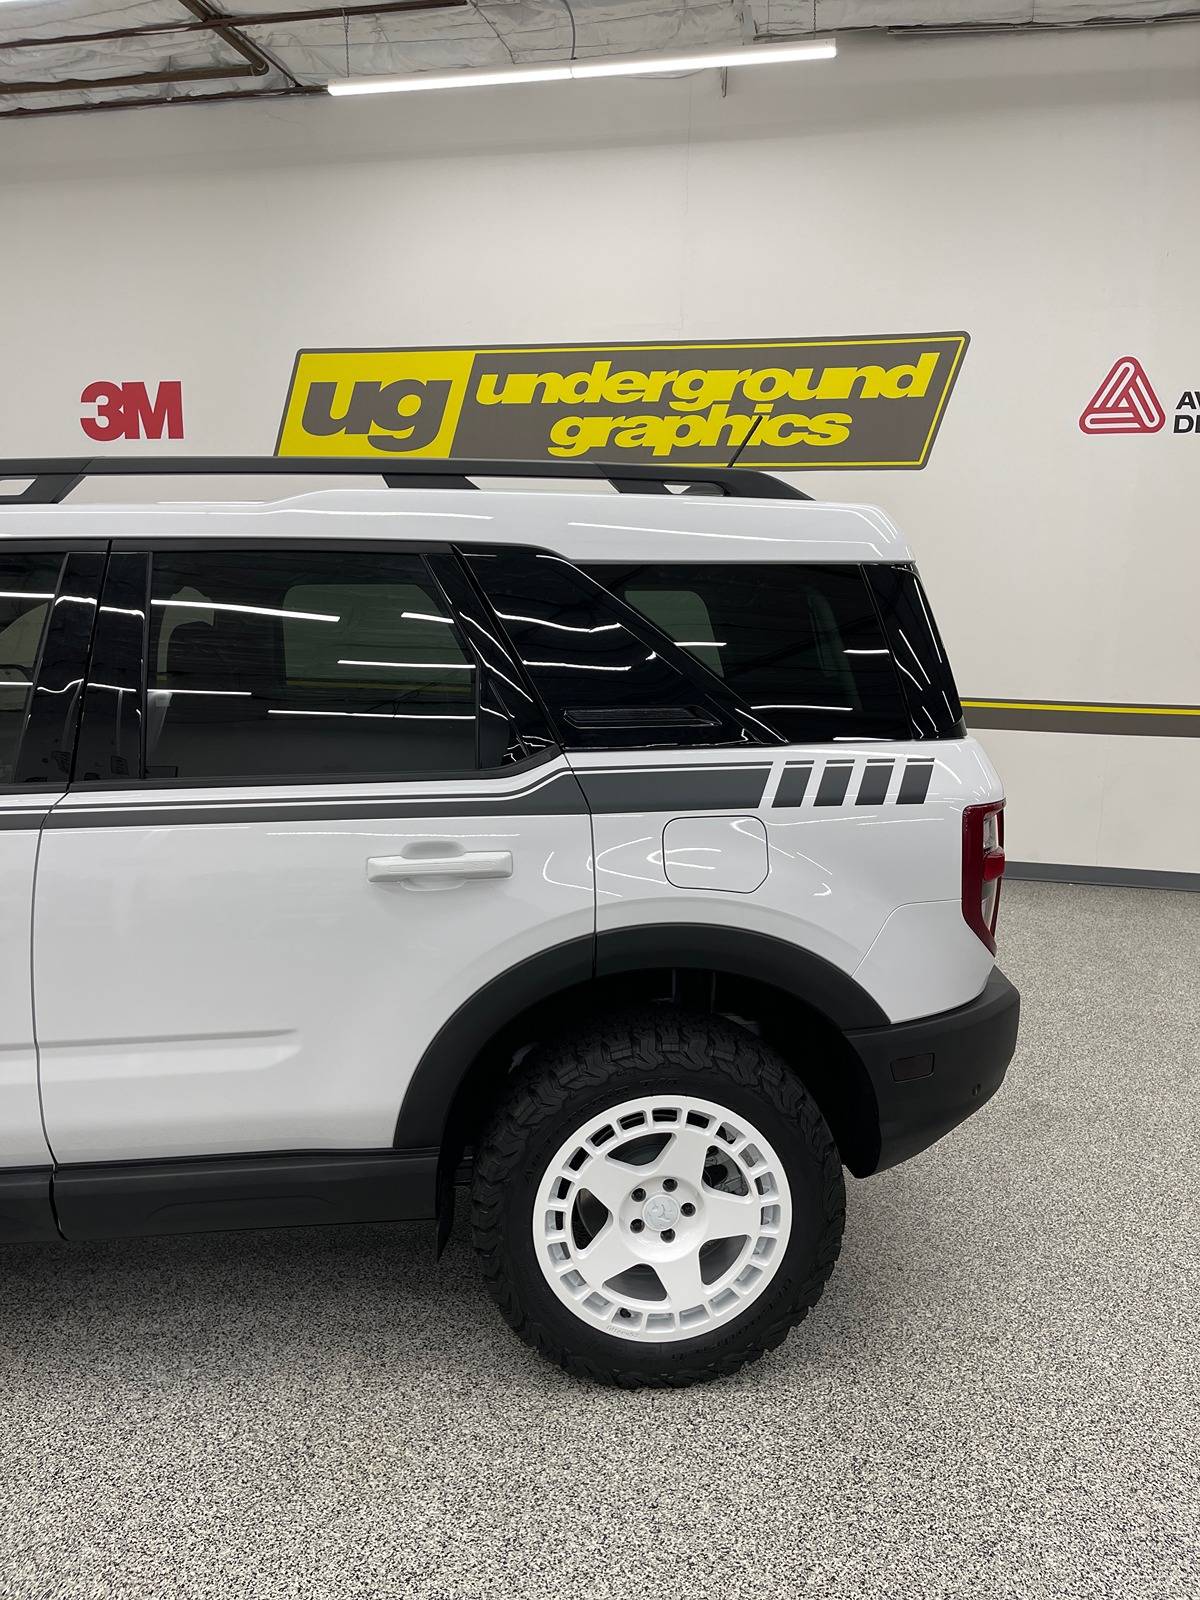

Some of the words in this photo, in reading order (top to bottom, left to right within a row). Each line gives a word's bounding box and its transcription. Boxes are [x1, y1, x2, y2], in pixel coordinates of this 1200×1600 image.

[80, 381, 184, 442] 3M
[474, 351, 941, 412] underground
[302, 380, 452, 452] ug
[547, 403, 853, 458] graphics
